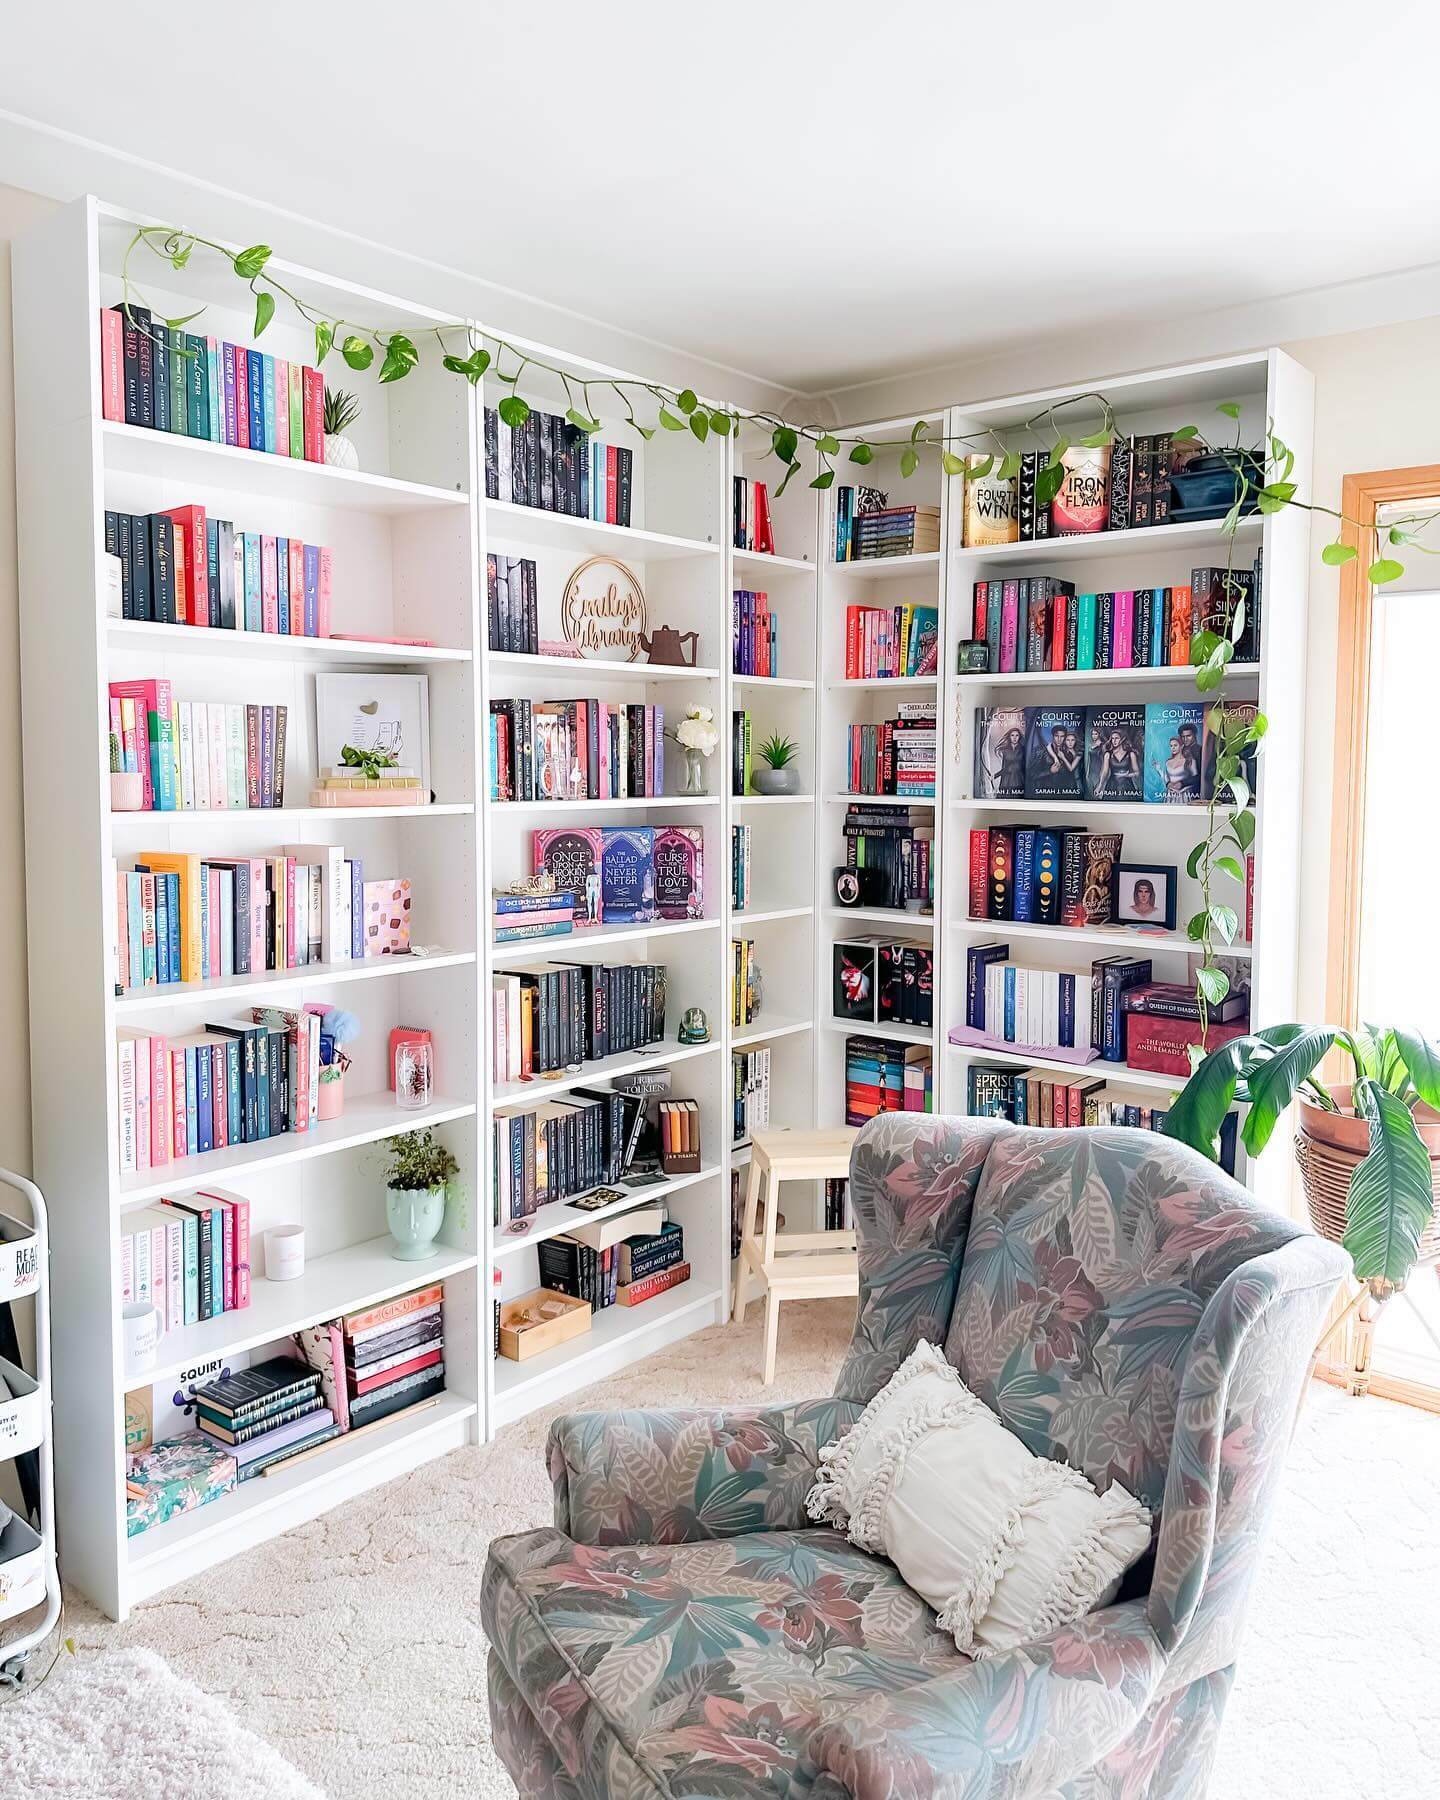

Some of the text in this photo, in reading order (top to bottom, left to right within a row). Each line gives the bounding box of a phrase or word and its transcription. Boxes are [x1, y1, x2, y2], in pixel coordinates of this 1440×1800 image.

[127, 333, 136, 358] BIRD
[225, 346, 233, 360] FIX
[140, 335, 149, 377] SECRETS
[226, 375, 233, 384] UP
[1069, 477, 1106, 492] IRON
[1213, 572, 1255, 584] A COURT
[1103, 597, 1111, 623] COURT
[1102, 627, 1110, 644] MIST
[1141, 646, 1149, 665] RUIN
[158, 682, 171, 750] Happy Place
[1041, 712, 1075, 720] COURT
[1102, 711, 1138, 719] COURT
[1162, 709, 1197, 718] COURT
[1093, 719, 1118, 727] WINGS
[884, 723, 893, 780] SMALL SPACES
[1155, 791, 1178, 799] SARAH
[551, 851, 586, 862] ONCE
[657, 852, 689, 862] CURSE
[1016, 833, 1024, 867] CRESCENT
[552, 862, 575, 870] UPON
[605, 855, 638, 864] BALLAD
[1023, 834, 1032, 890] SARAH MAAS
[552, 868, 586, 878] BROKEN
[605, 868, 637, 876] NEVER
[657, 866, 688, 876] TRUE
[554, 876, 587, 886] HEART
[605, 876, 638, 885] AFTER
[658, 877, 689, 887] LOVE
[1065, 874, 1073, 892] CITY
[239, 869, 247, 909] CROSSED
[145, 915, 153, 945] COMPLEX
[1149, 1003, 1168, 1011] QUEEN
[1146, 1038, 1185, 1049] THE WORLD
[1153, 1045, 1180, 1056] REMADE
[122, 1060, 132, 1088] ROAD
[156, 1084, 164, 1103] CALL
[624, 1084, 665, 1094] TOLKIEN
[976, 1088, 1015, 1104] HEALE
[122, 1091, 132, 1114] TRIP
[171, 1227, 179, 1273] ELSIE SILVER
[188, 1221, 196, 1265] ELSIE SILVER
[633, 1232, 680, 1255] COURT WINGS RUIN
[16, 1259, 38, 1277] MOR
[634, 1250, 681, 1274] COURT MIST FURY
[630, 1274, 670, 1296] SARAH MAAS
[180, 1358, 224, 1383] SQUIRT
